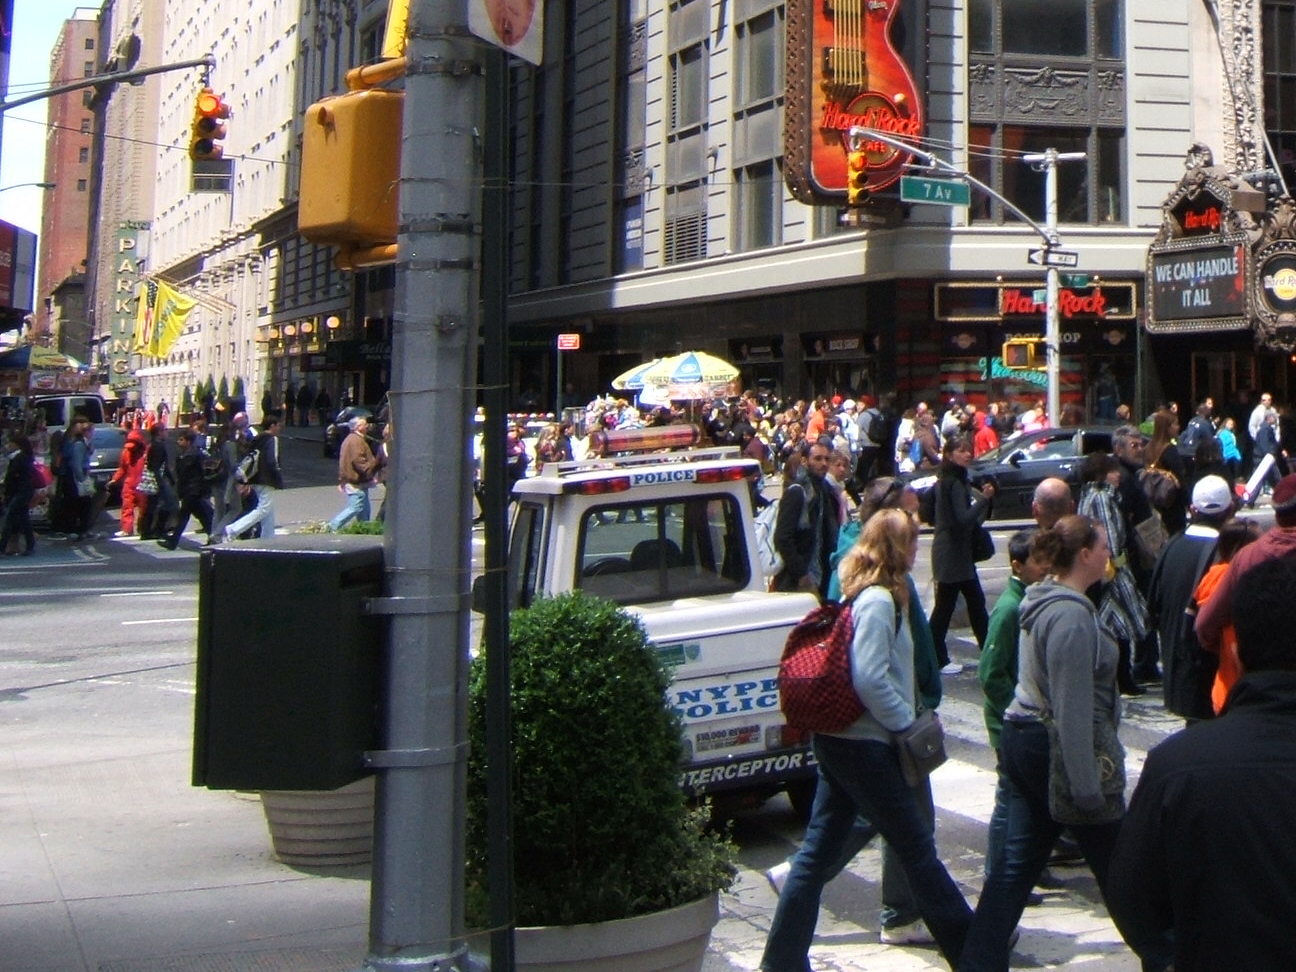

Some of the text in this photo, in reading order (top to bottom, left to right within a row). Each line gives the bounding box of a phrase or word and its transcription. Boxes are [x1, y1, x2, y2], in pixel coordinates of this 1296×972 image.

[822, 102, 920, 136] Hard Rock
[923, 183, 932, 198] 7
[1155, 256, 1239, 282] WE CAN HANDLE
[112, 238, 136, 374] PARKING
[1058, 289, 1107, 318] Rock
[1182, 288, 1212, 307] IT ALL
[632, 469, 694, 484] POLICE
[671, 694, 777, 718] OLIC
